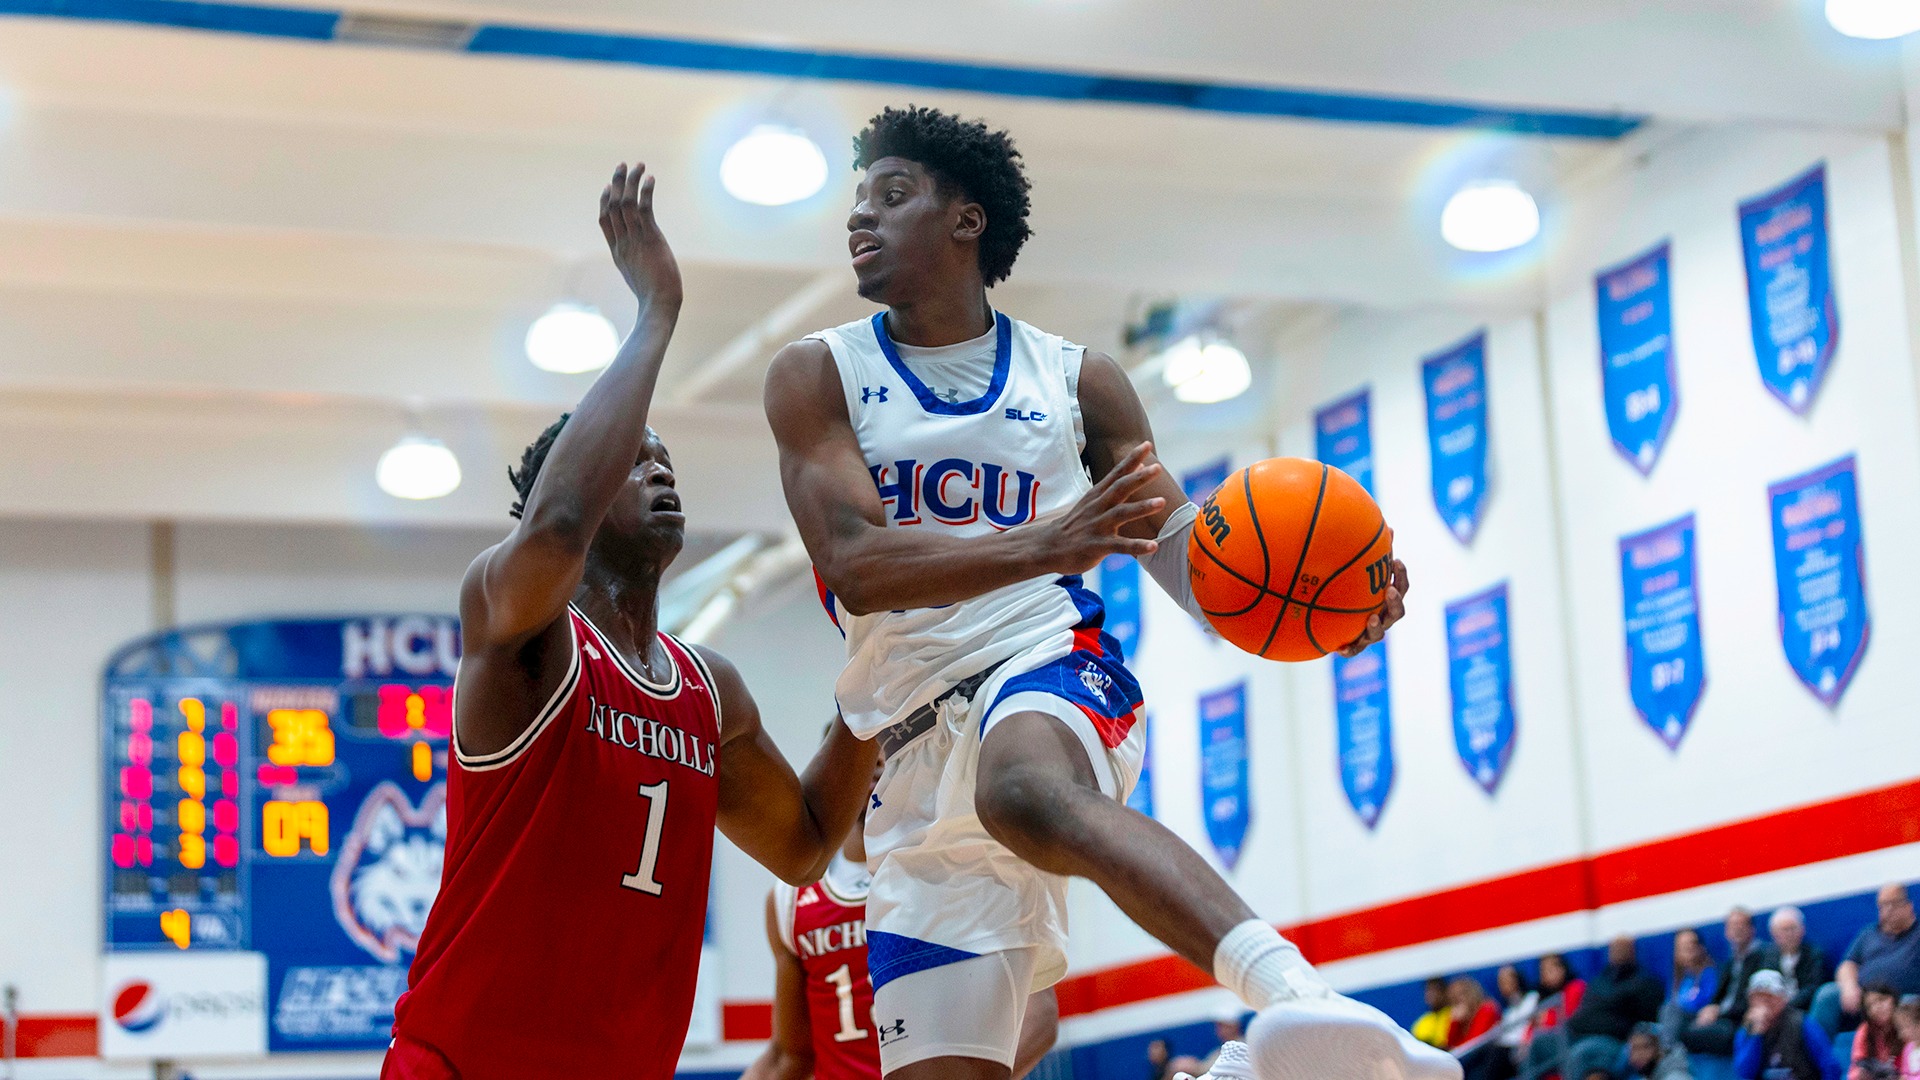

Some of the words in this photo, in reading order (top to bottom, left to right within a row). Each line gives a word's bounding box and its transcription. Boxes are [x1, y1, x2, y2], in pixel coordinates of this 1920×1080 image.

[1005, 408, 1043, 421] SLC
[869, 458, 1040, 531] HCU
[1301, 573, 1319, 586] GB
[586, 696, 715, 777] NICHOLLS
[620, 779, 669, 897] 1
[797, 919, 867, 960] NICH
[825, 963, 876, 1042] 1
